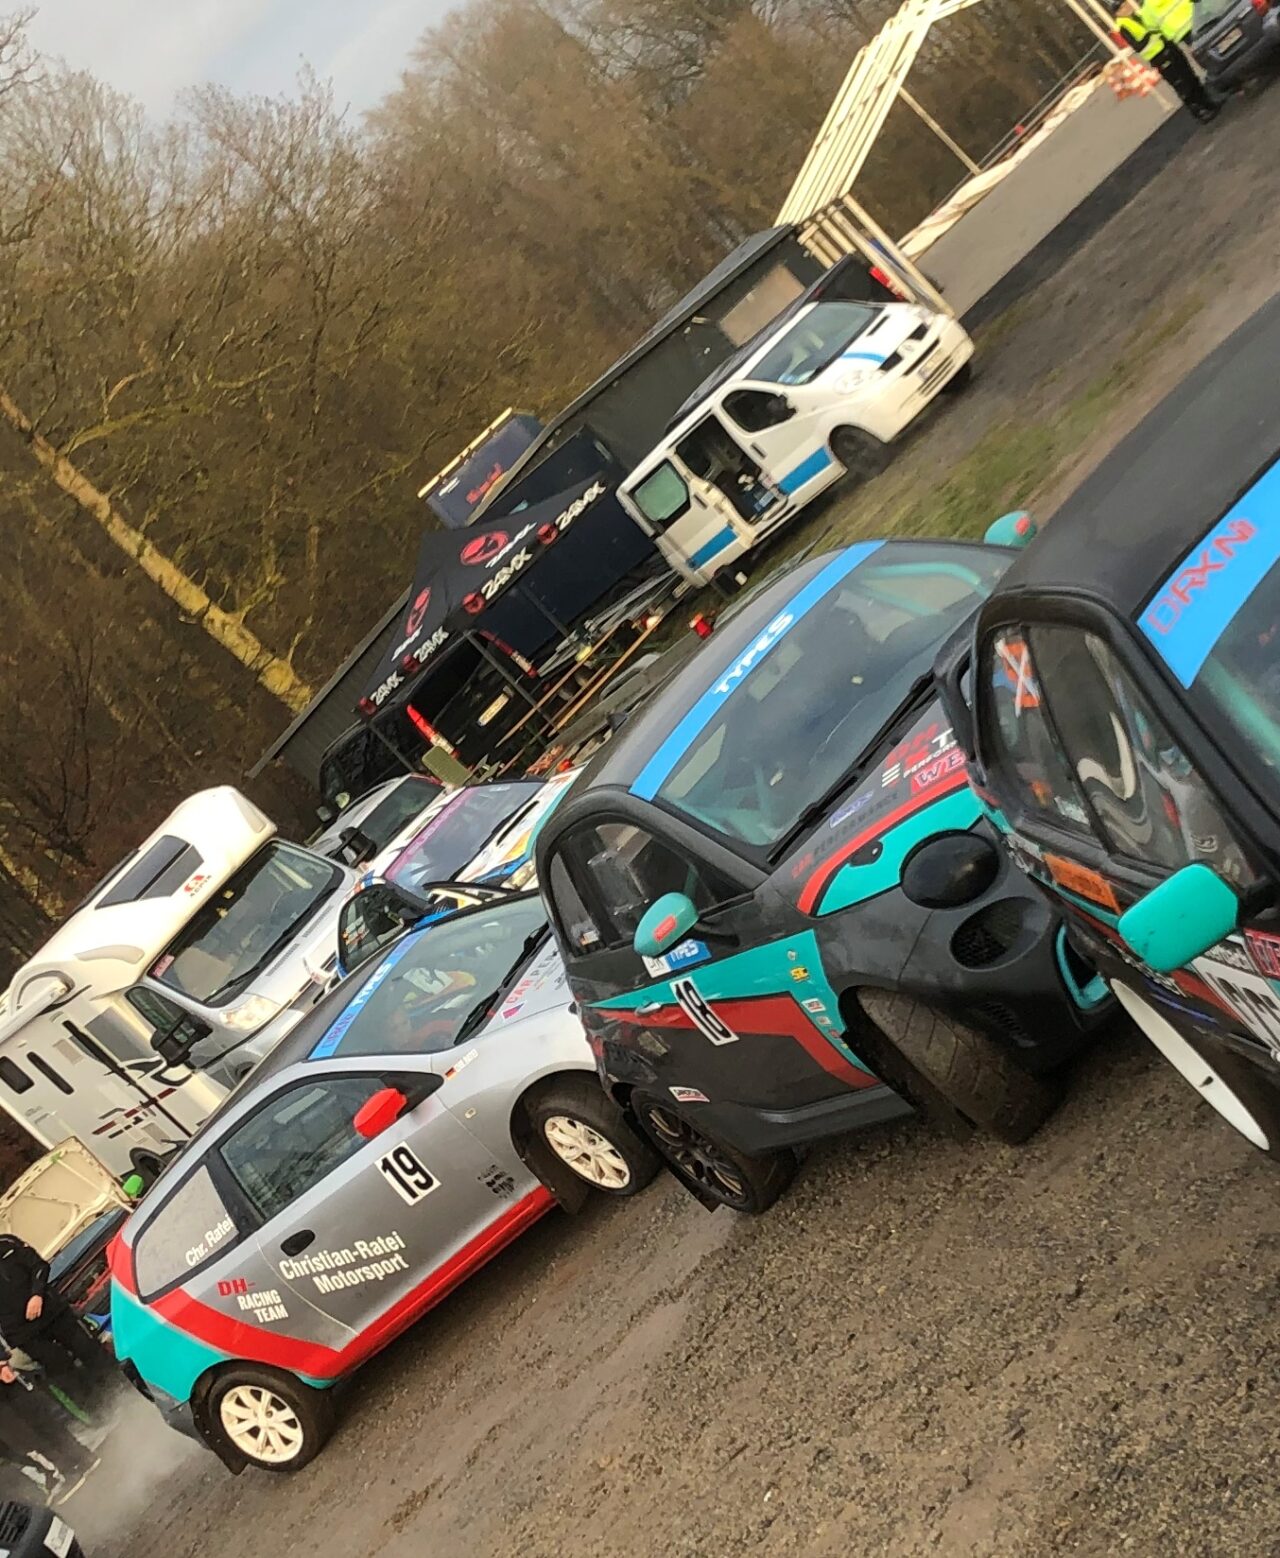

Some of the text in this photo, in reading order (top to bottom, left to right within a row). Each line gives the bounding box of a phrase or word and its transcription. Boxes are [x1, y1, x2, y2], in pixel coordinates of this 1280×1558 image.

[675, 980, 733, 1041] 18
[381, 1146, 434, 1199] 19
[185, 1214, 235, 1267] Chr. Ratei
[278, 1231, 407, 1280] Christian-Ratei
[216, 1278, 257, 1297] DH-
[312, 1253, 410, 1294] Motorsport
[236, 1289, 281, 1311] RACING
[253, 1304, 289, 1323] TEAM
